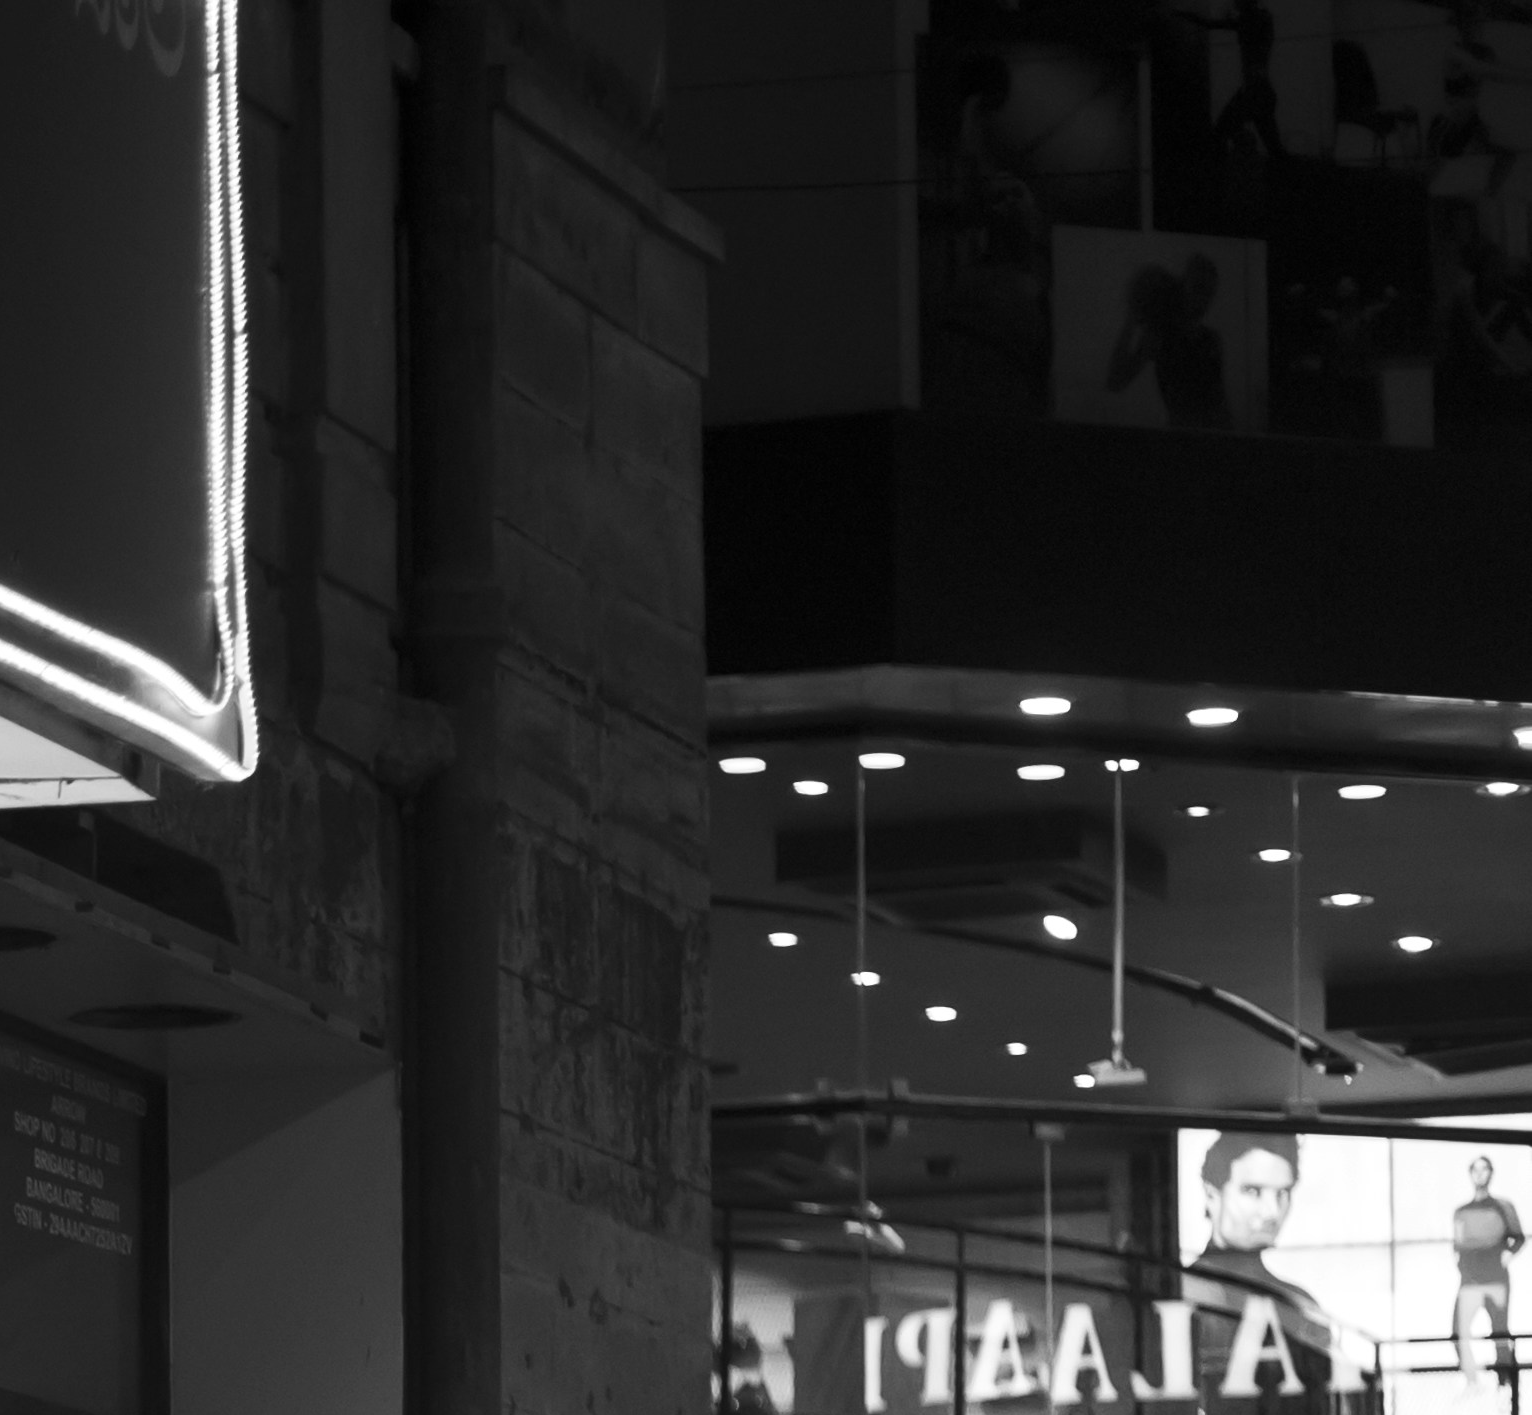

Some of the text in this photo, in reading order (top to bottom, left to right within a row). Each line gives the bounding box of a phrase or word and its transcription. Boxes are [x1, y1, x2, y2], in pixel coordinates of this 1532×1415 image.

[13, 1110, 40, 1138] SHOP
[41, 1119, 57, 1144] NO
[33, 1146, 105, 1190] BRIGADE ROAD
[24, 1176, 84, 1215] BANGALORE
